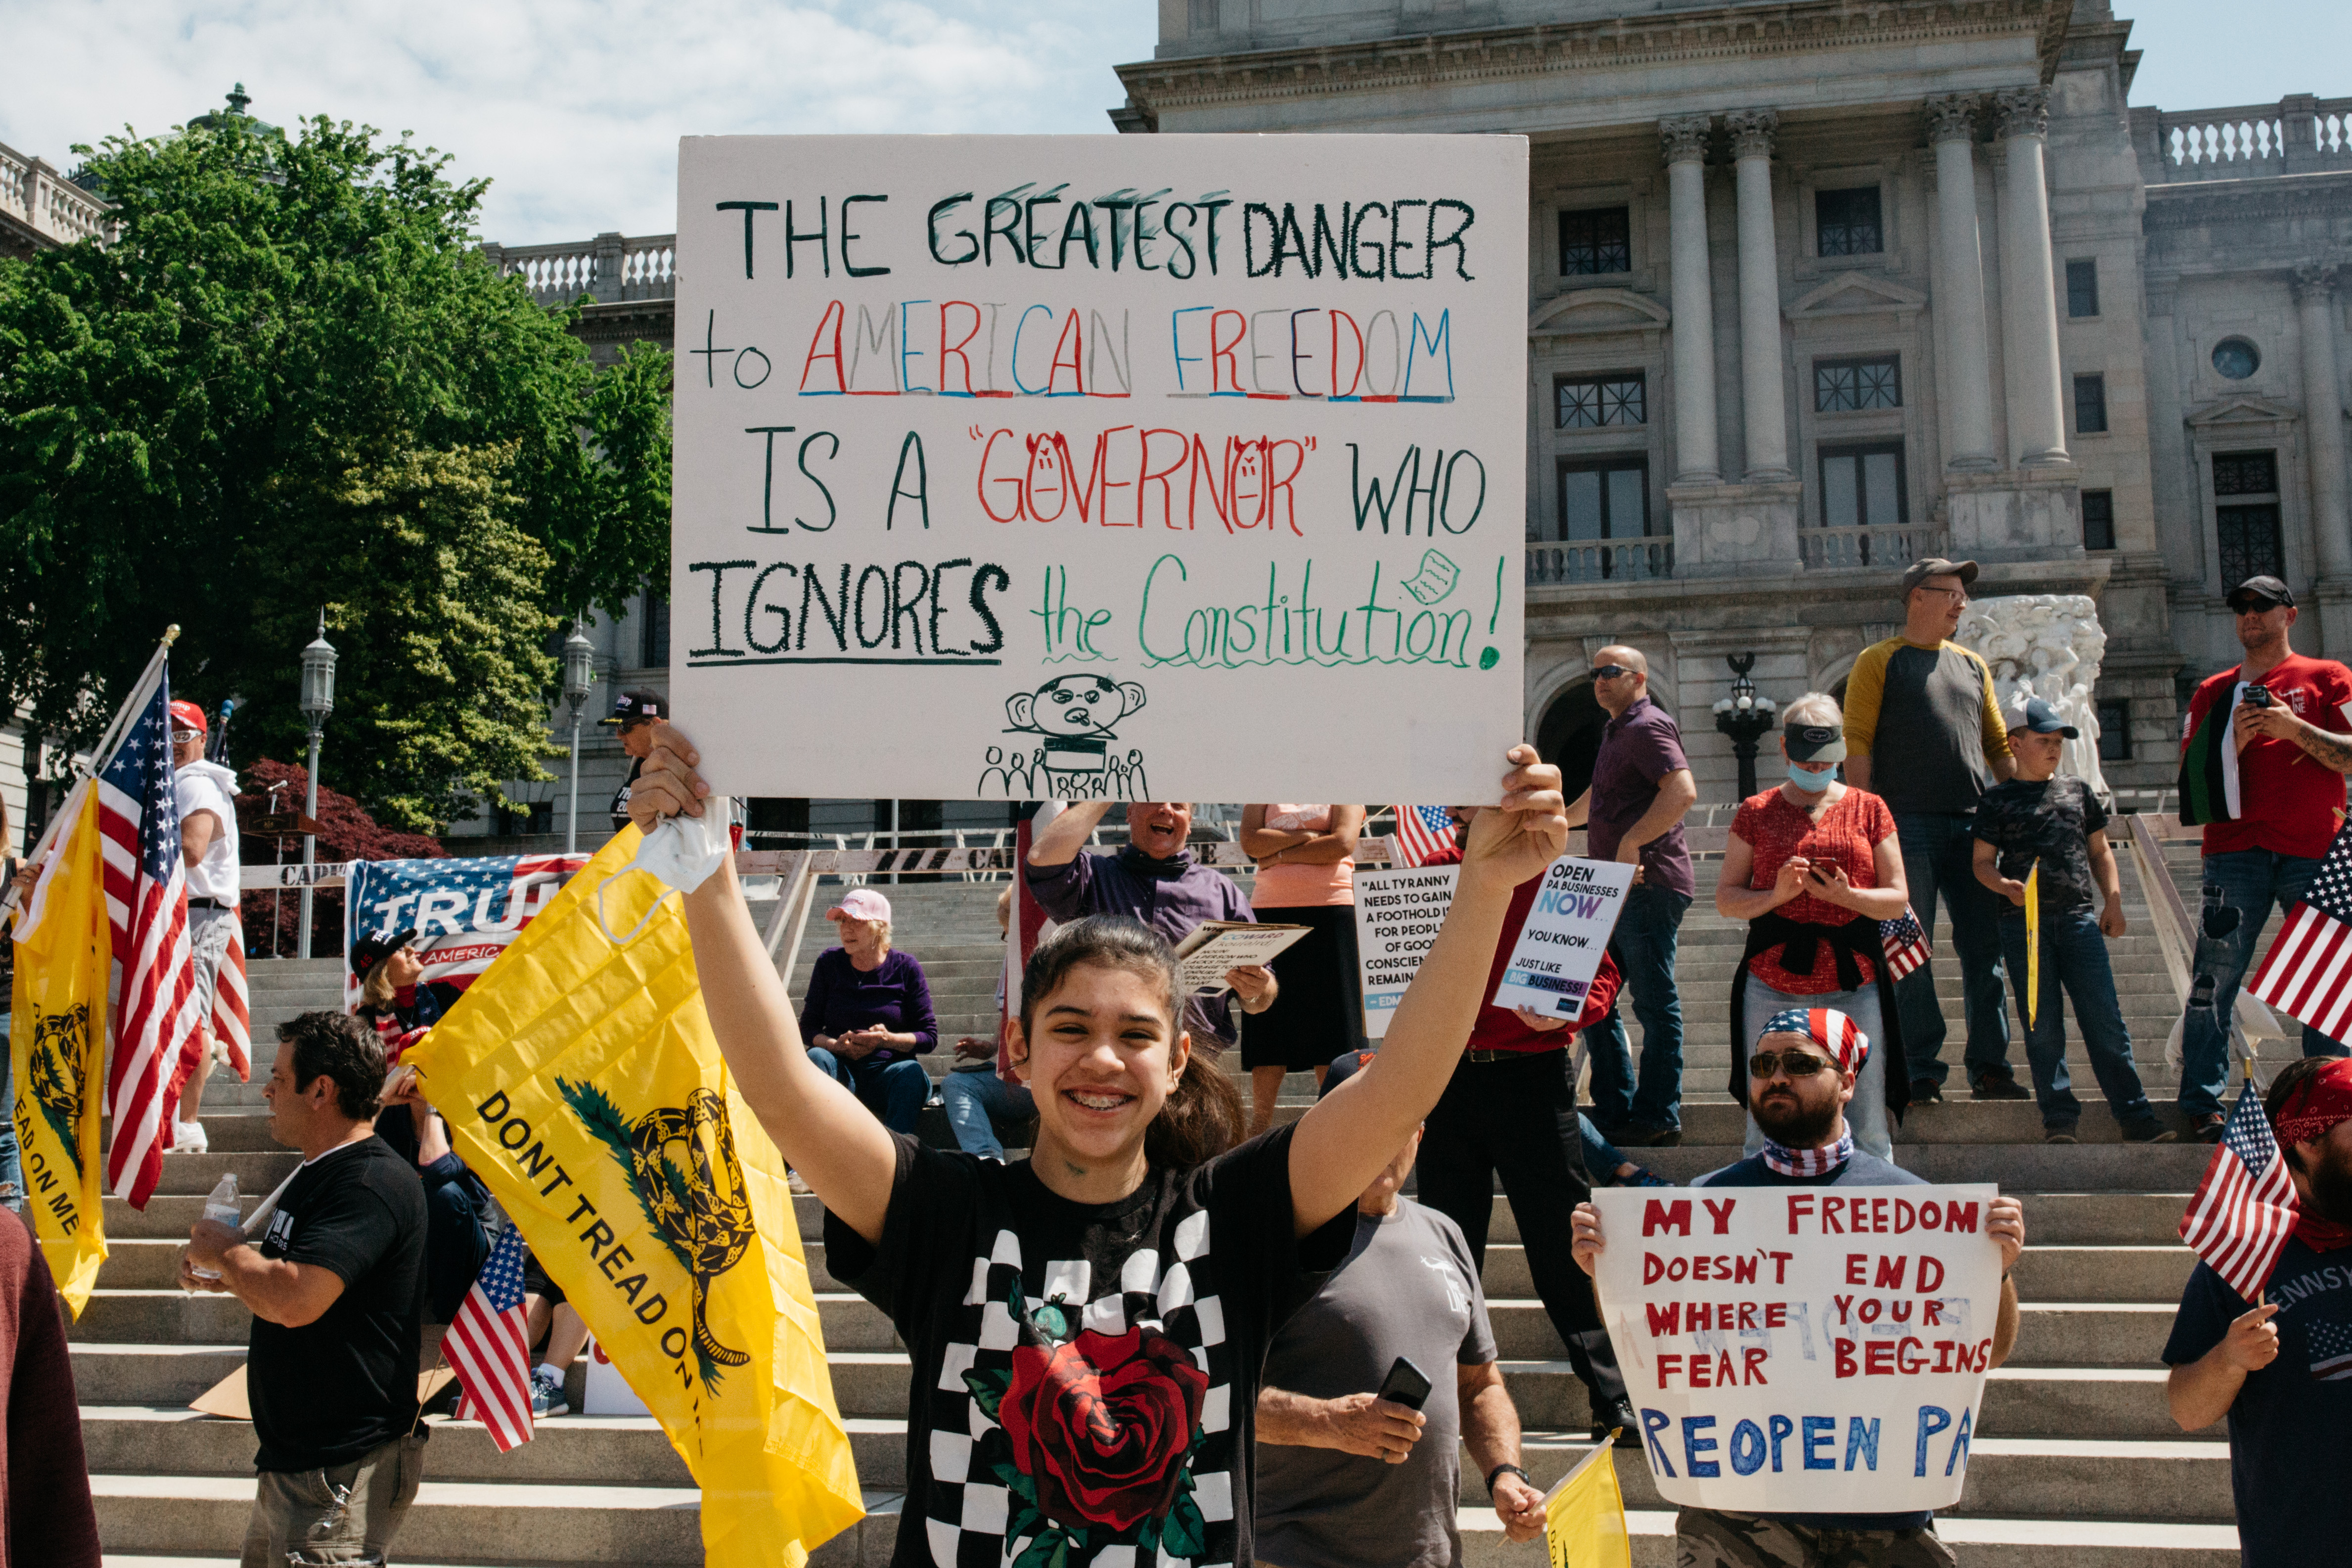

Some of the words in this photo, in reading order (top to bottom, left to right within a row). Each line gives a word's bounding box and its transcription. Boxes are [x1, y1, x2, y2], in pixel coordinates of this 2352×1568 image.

[716, 194, 891, 279] THE
[928, 185, 1234, 279] GREATEST
[1243, 199, 1475, 281] DANGER
[690, 309, 771, 389] to
[800, 300, 1131, 395] AMERICAN
[1173, 306, 1454, 397] FREEDOM
[745, 426, 840, 534] IS
[887, 430, 929, 531] A
[1345, 443, 1486, 537] WHO
[688, 558, 1012, 658] IGNORES
[1029, 564, 1112, 656] the
[1362, 880, 1390, 892] "ALL
[1392, 875, 1450, 890] TYRANNY
[1552, 864, 1595, 882] OPEN
[1364, 895, 1402, 907] NEEDS
[1403, 893, 1420, 904] TO
[1422, 891, 1452, 902] GAIN
[1546, 880, 1559, 890] PA
[1561, 881, 1619, 897] BUSINESSES
[1366, 913, 1374, 923] A
[1376, 908, 1441, 922] FOOTHOLD
[1375, 927, 1399, 938] FOR
[1528, 929, 1552, 942] YOU
[424, 946, 500, 964] AMERIC
[1385, 941, 1401, 952] OF
[1403, 939, 1436, 951] GOO
[1515, 957, 1540, 969] JUST
[1539, 961, 1562, 974] LIKE
[1368, 972, 1414, 986] REMAIN
[1509, 971, 1528, 985] BIG
[1528, 975, 1584, 994] BUSINESS!
[30, 1153, 59, 1193] ON
[48, 1192, 80, 1236] ME
[1641, 1198, 1737, 1237] MY
[1787, 1194, 1980, 1235] FREEDOM
[1845, 1253, 1945, 1293] END
[566, 1194, 668, 1325] TREAD
[661, 1327, 693, 1390] ON
[1645, 1301, 1787, 1338] WHERE
[1833, 1294, 1946, 1327] YOUR
[1656, 1348, 1768, 1389] FEAR
[1834, 1336, 1992, 1379] BEGINS
[1640, 1407, 1881, 1478] REOPEN
[1913, 1404, 1972, 1478] PA
